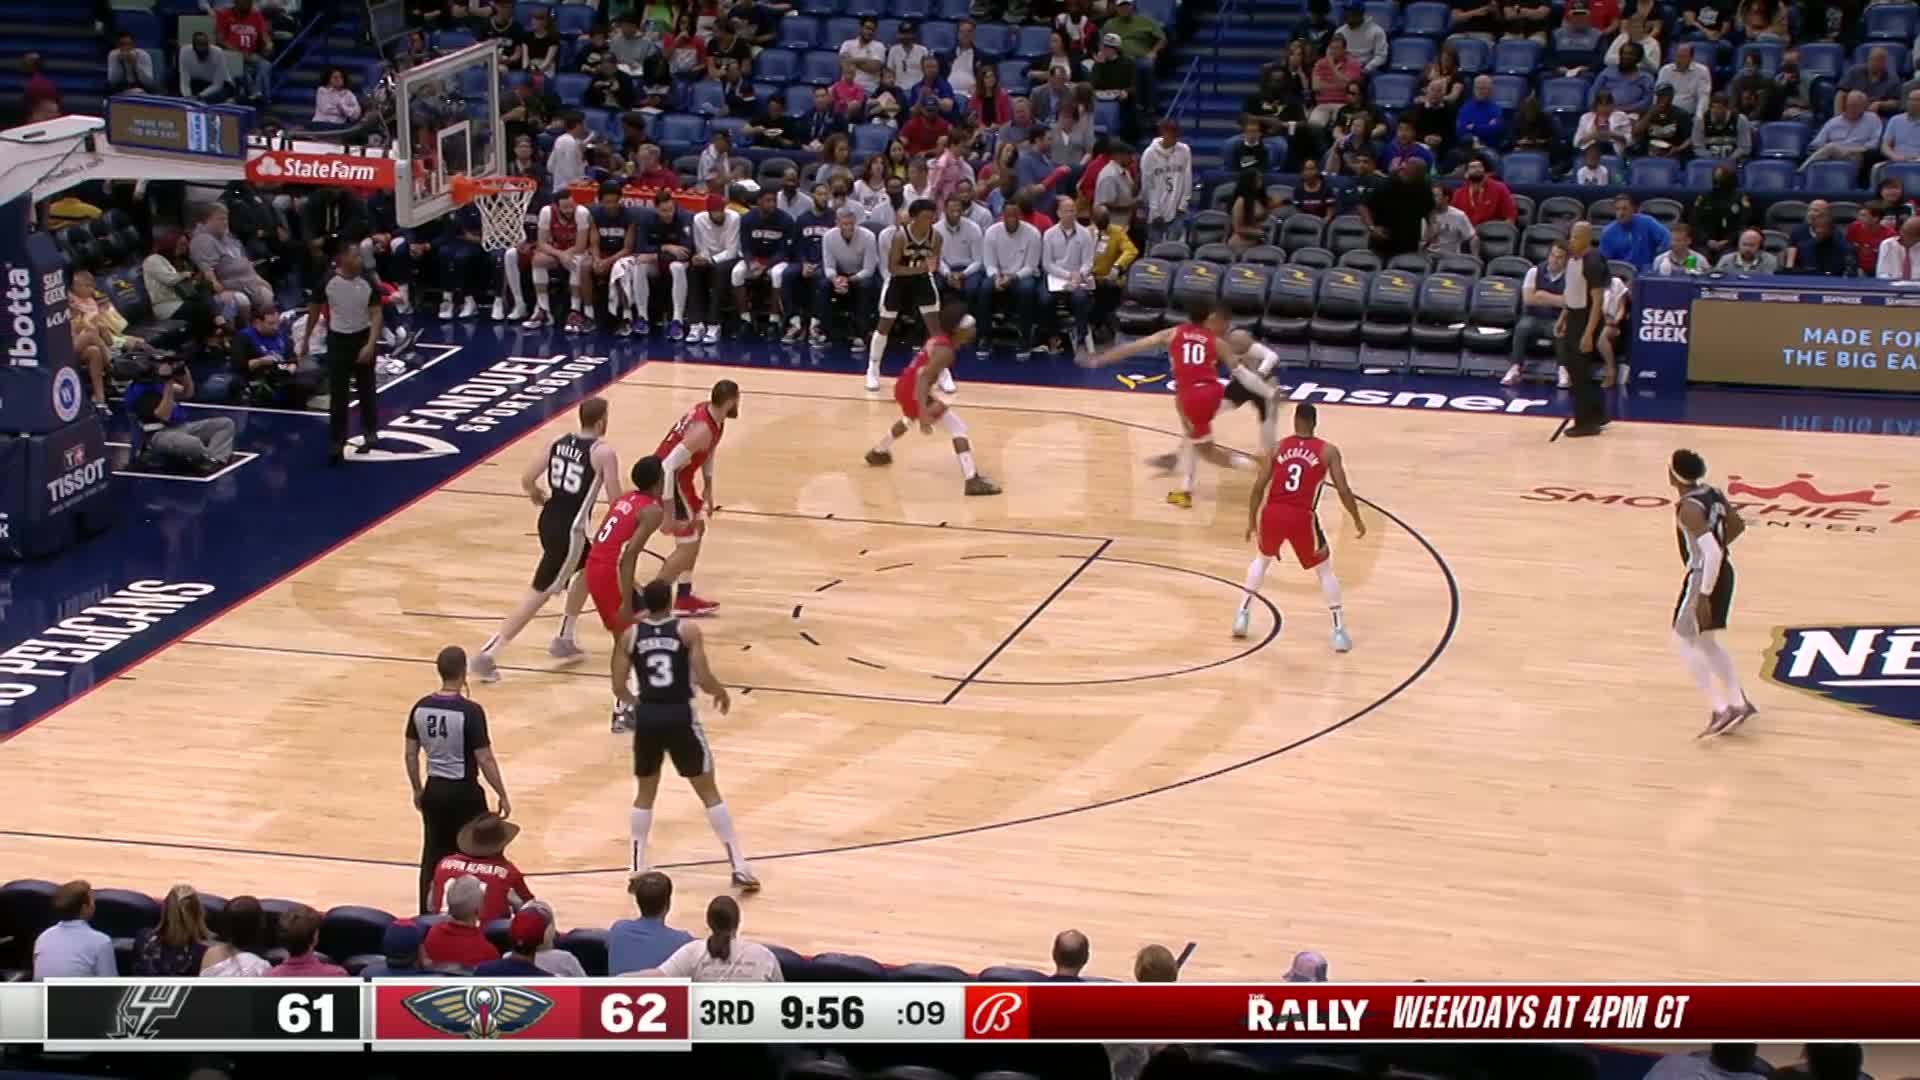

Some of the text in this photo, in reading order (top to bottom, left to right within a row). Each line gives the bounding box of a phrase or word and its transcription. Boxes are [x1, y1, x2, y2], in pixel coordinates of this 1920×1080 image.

[6, 268, 39, 367] ibotta
[1641, 308, 1689, 326] SEAT
[1639, 325, 1689, 344] GEEK
[1803, 327, 1873, 346] MADE
[1181, 342, 1206, 365] 10
[1783, 349, 1920, 371] THE BIG EA
[387, 354, 567, 430] FANDUEL
[455, 355, 609, 432] SPORTSBOOK
[47, 457, 106, 502] TISSOT
[550, 456, 585, 495] 25
[1284, 463, 1302, 492] 3
[1520, 486, 1872, 521] SMOTHIE
[598, 516, 619, 542] 5
[0, 579, 216, 677] PELICANS
[646, 653, 674, 688] 3
[427, 714, 448, 739] 24
